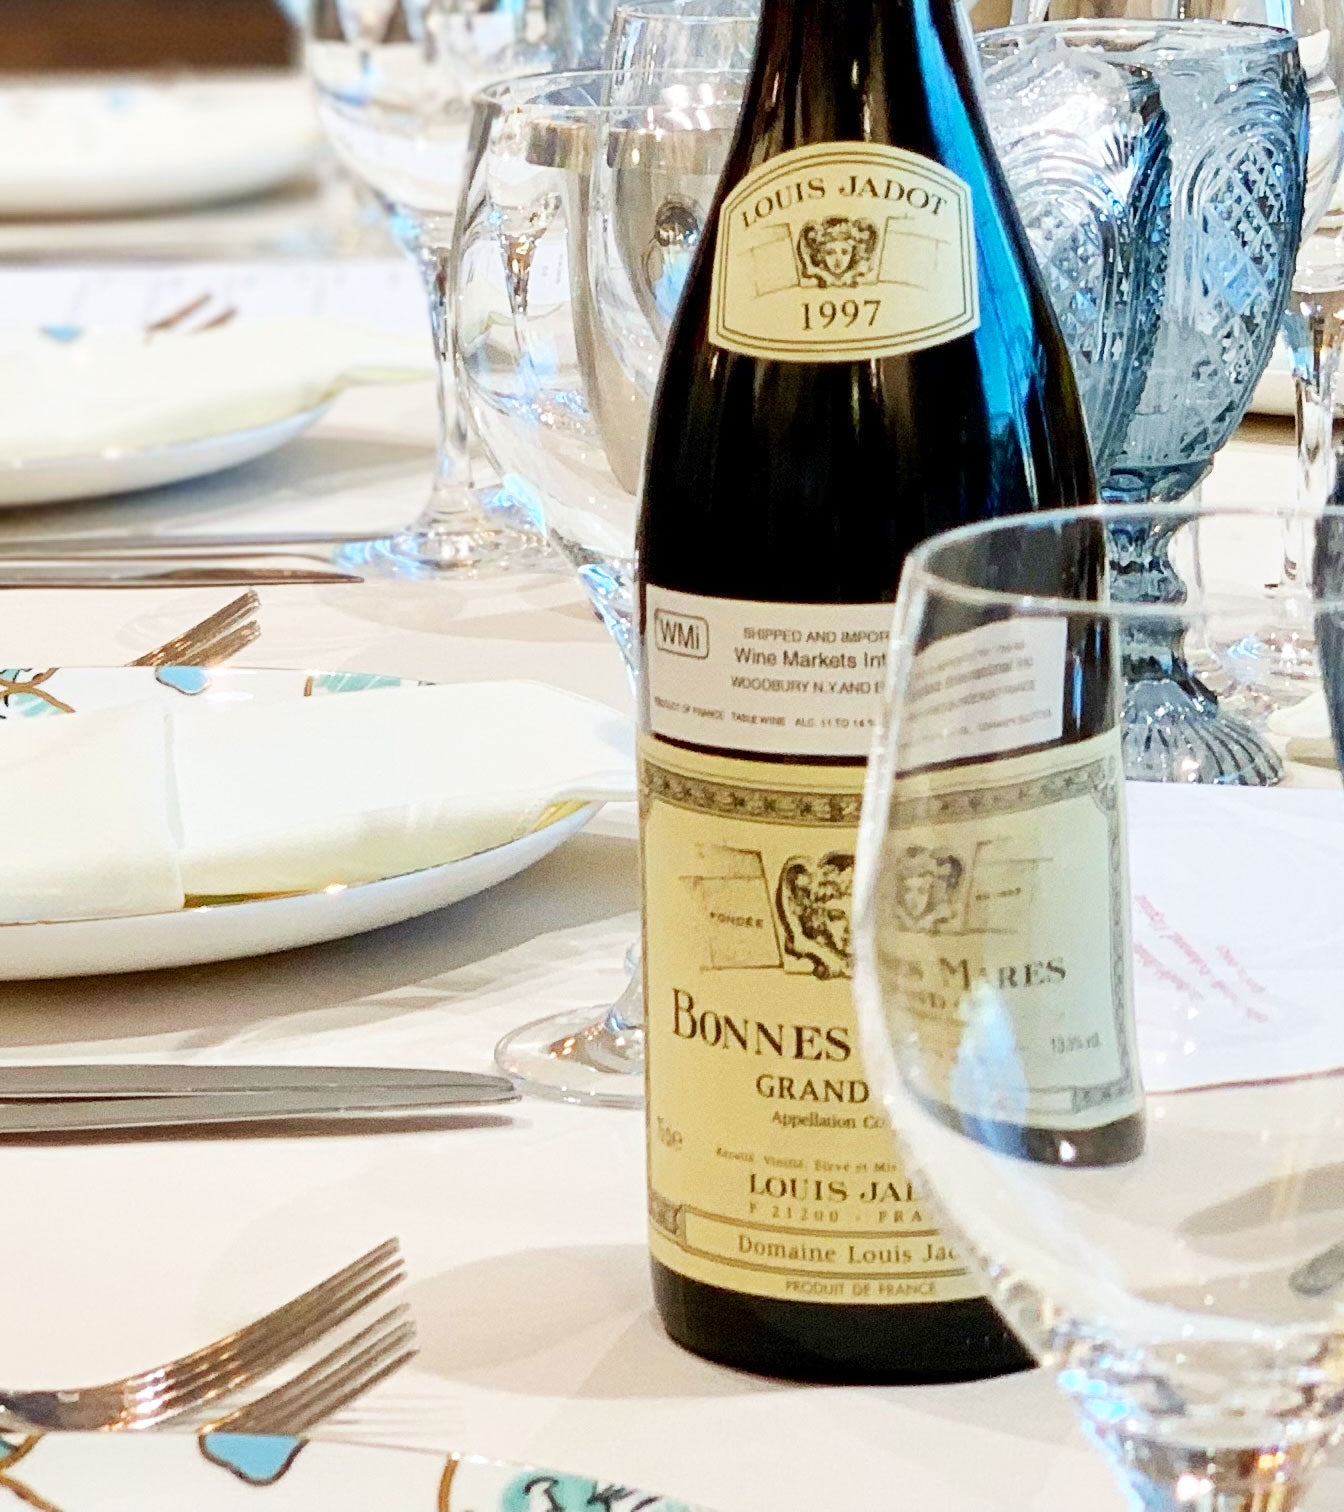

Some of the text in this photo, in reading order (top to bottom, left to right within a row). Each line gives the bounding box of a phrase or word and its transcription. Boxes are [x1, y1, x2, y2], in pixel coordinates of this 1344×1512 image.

[742, 176, 947, 228] LOUIS JADOT
[801, 299, 881, 330] 1997
[743, 627, 802, 643] SHIPPED
[806, 631, 836, 643] AND
[734, 646, 777, 666] Wine
[783, 649, 857, 669] Markets
[672, 987, 851, 1062] BONNES
[756, 1073, 870, 1104] GRAND
[772, 1110, 856, 1129] Appellation
[750, 1173, 848, 1202] LOUIS
[878, 1210, 923, 1223] FRA
[738, 1234, 837, 1263] Domaine
[848, 1245, 913, 1264] Louis
[785, 1280, 936, 1296] PRODUIT DE FRANCE
